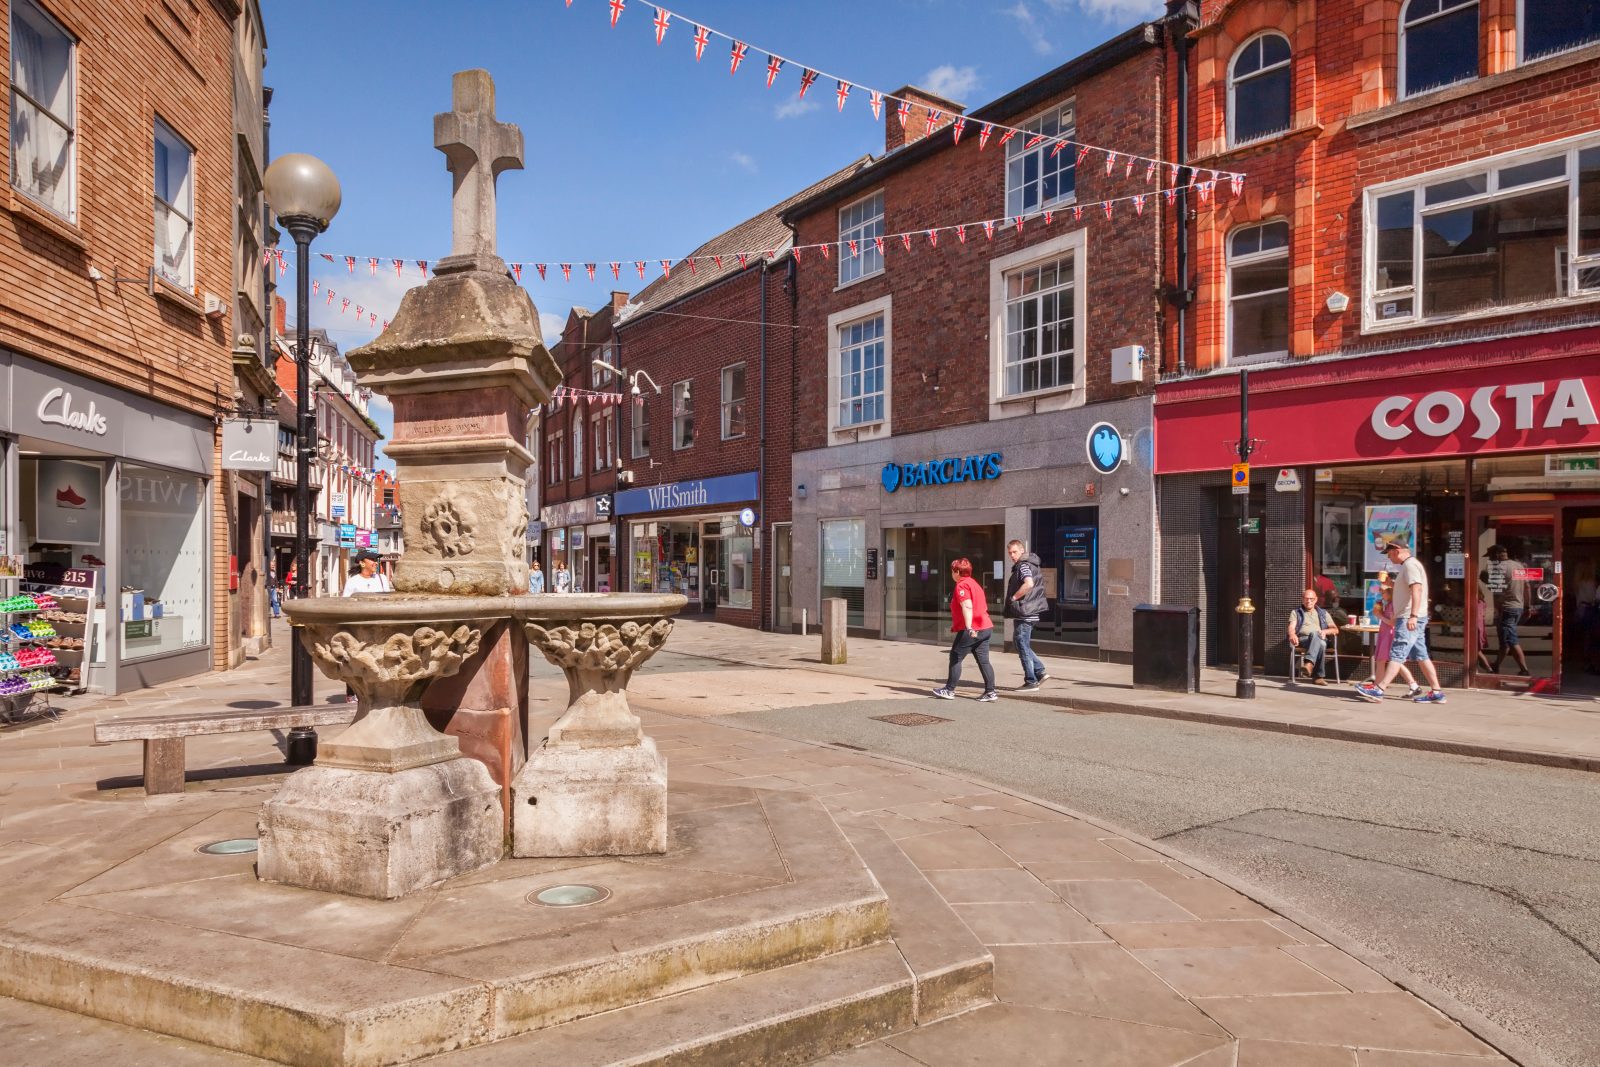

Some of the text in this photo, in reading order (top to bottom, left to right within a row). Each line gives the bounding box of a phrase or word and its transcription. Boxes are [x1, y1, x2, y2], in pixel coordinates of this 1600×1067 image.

[38, 387, 107, 434] Clarks
[1371, 378, 1599, 441] COSTA
[229, 450, 271, 462] Clarks
[902, 452, 1003, 488] BARCLAYS
[648, 481, 707, 511] WHSmith
[63, 570, 87, 583] £15
